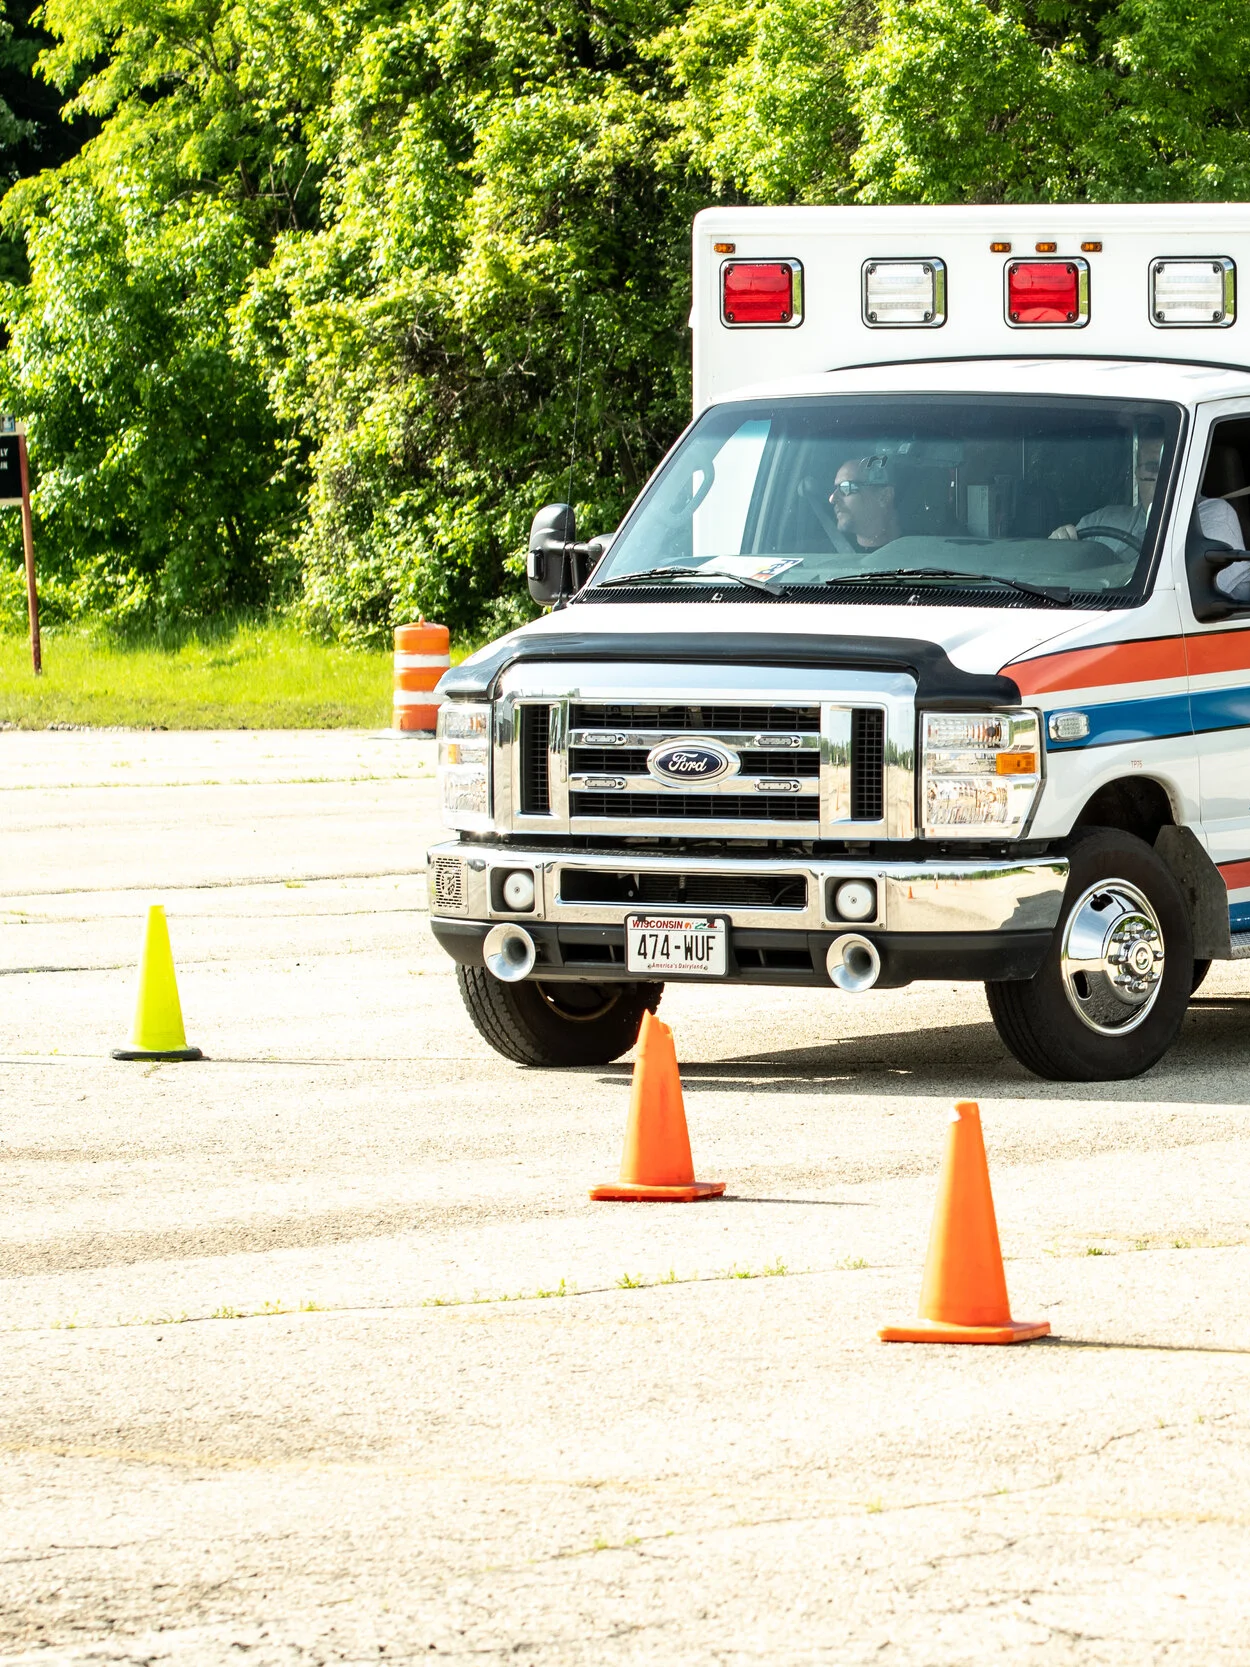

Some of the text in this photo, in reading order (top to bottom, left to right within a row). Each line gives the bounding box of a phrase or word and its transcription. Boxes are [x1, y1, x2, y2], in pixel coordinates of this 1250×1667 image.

[668, 752, 708, 772] Ford
[632, 920, 684, 929] WISCONSIN
[637, 934, 716, 961] 474-WUF
